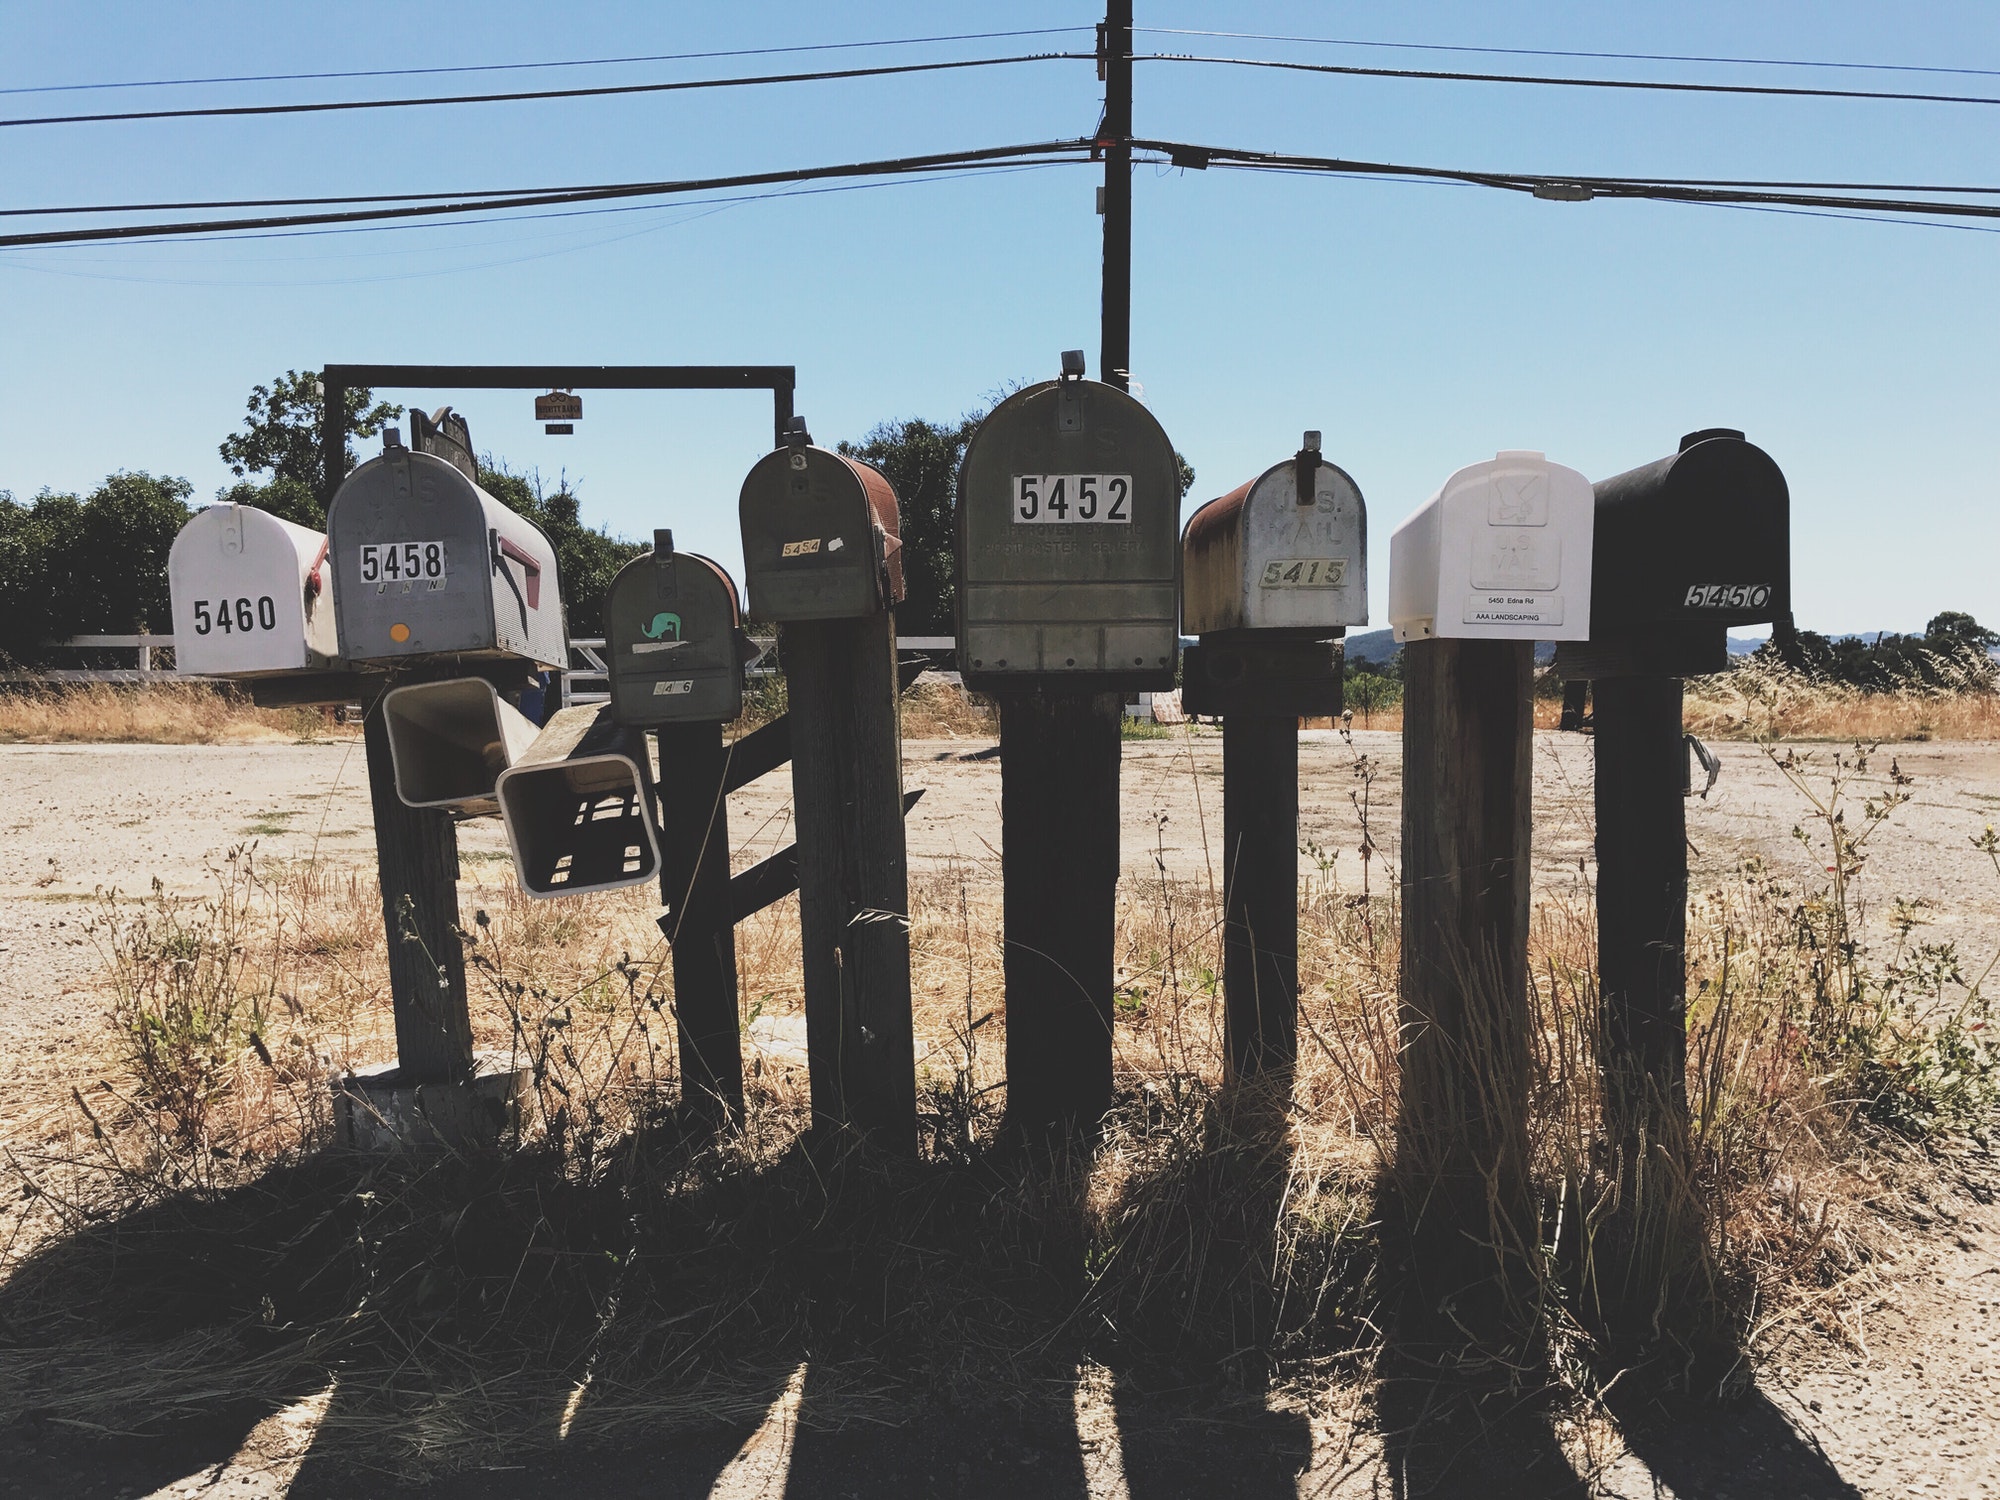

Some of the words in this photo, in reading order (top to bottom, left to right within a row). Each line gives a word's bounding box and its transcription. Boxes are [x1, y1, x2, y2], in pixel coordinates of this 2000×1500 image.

[1019, 477, 1128, 520] 5452
[784, 540, 819, 555] 5454
[362, 543, 442, 582] 5458
[1264, 561, 1344, 584] 5415
[1525, 597, 1535, 605] Rd
[1685, 584, 1771, 608] 5450
[194, 596, 276, 636] 5460
[1491, 613, 1540, 621] LANDSCAPING
